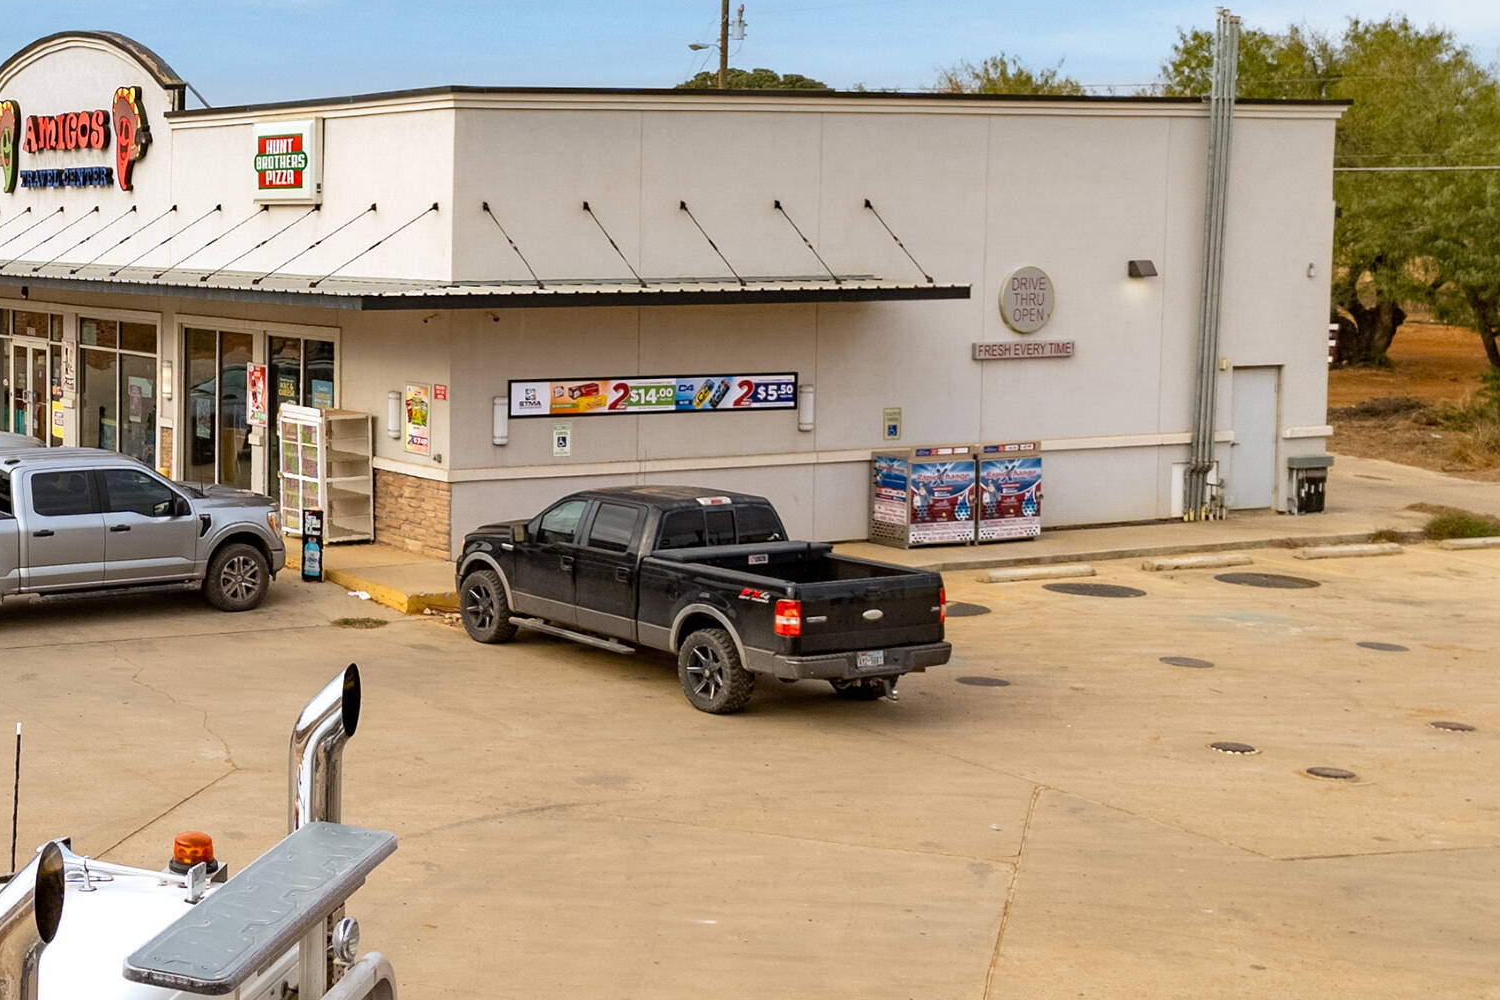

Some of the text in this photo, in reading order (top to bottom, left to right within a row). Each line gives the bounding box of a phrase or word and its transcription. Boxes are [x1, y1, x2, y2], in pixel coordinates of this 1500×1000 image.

[23, 109, 106, 153] AMIGOS
[265, 138, 294, 155] HUNT
[256, 153, 306, 170] BROTHERS
[20, 167, 107, 188] TRAVEL CENTER
[265, 169, 295, 186] PIZZA
[1011, 277, 1046, 292] DRIVE
[1013, 293, 1045, 306] THRU
[1012, 308, 1045, 322] OPEN
[978, 341, 1076, 357] FRESH EVERY TIME!
[607, 382, 631, 410] 2
[732, 379, 794, 407] 2 $5.50
